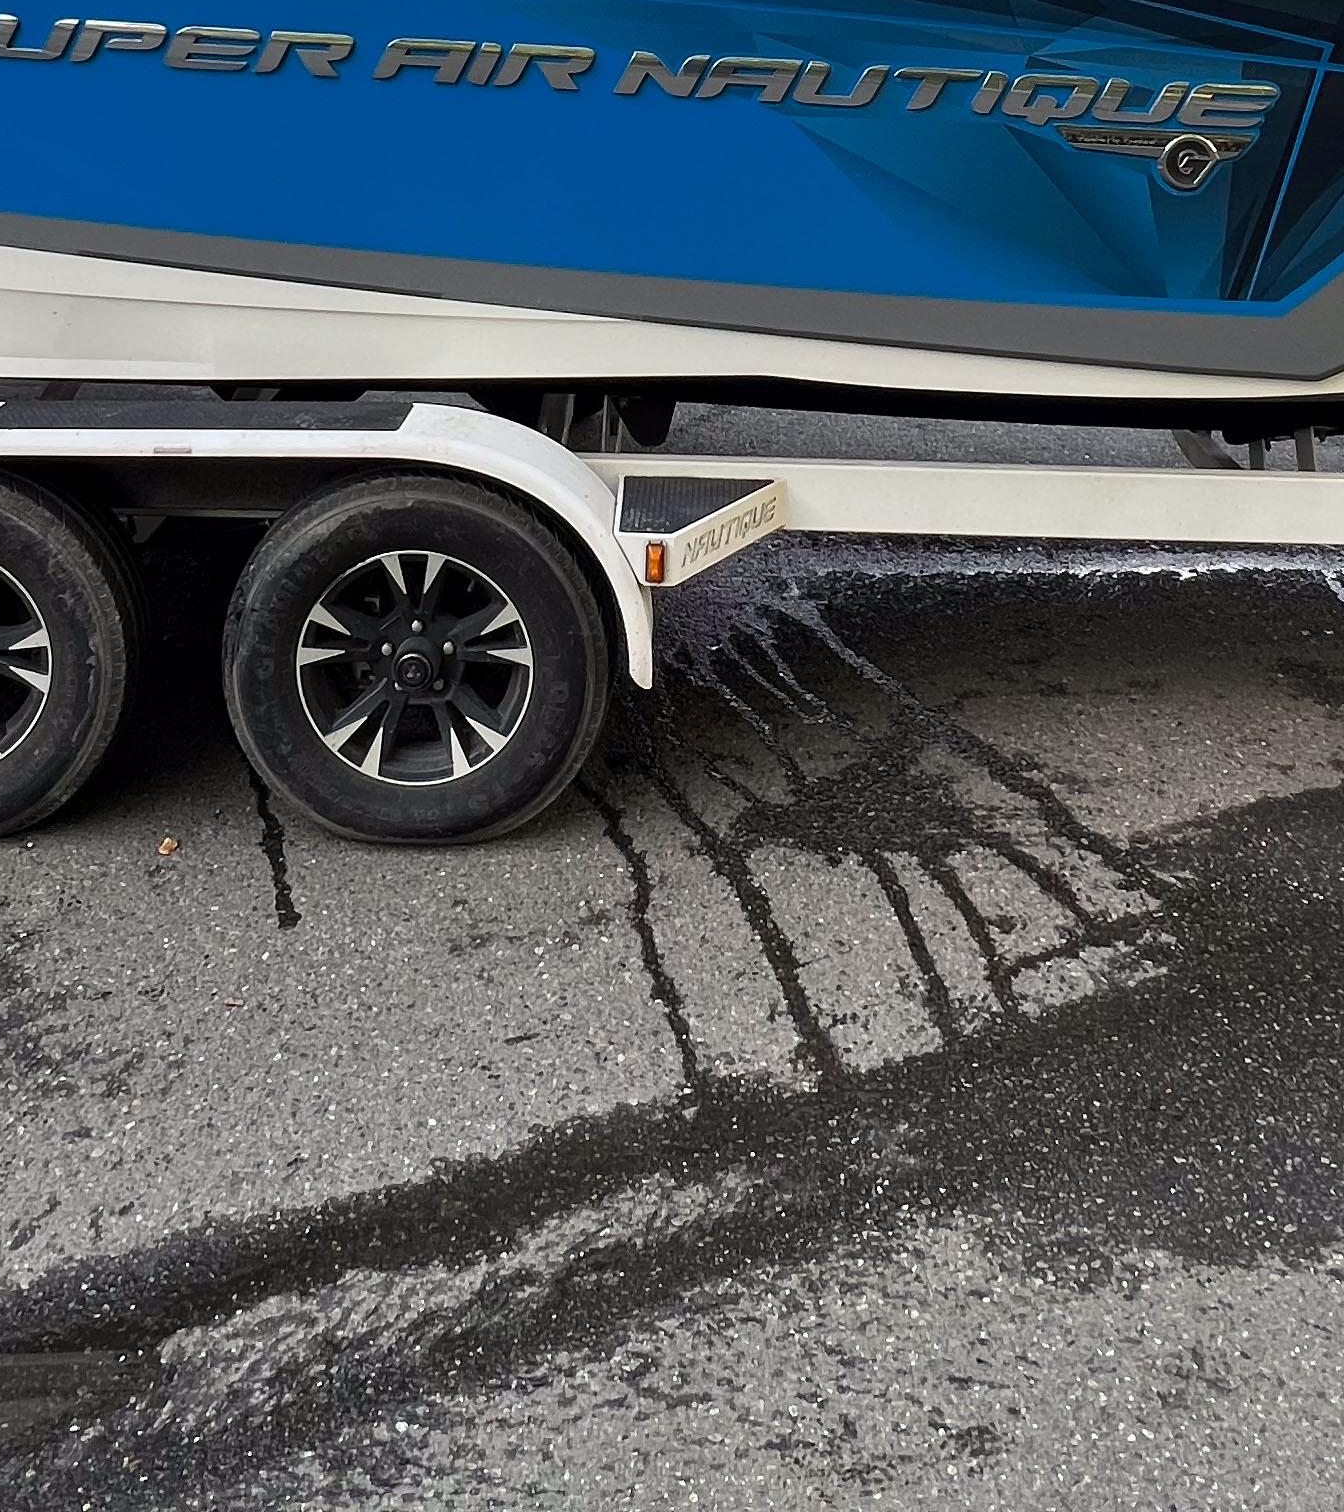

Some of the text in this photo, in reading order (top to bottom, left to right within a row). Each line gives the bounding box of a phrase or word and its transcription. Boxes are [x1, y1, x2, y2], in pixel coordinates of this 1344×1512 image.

[372, 37, 596, 90] AIR
[612, 49, 1280, 127] NAUTIQUE
[680, 496, 777, 569] NAUTIQUE
